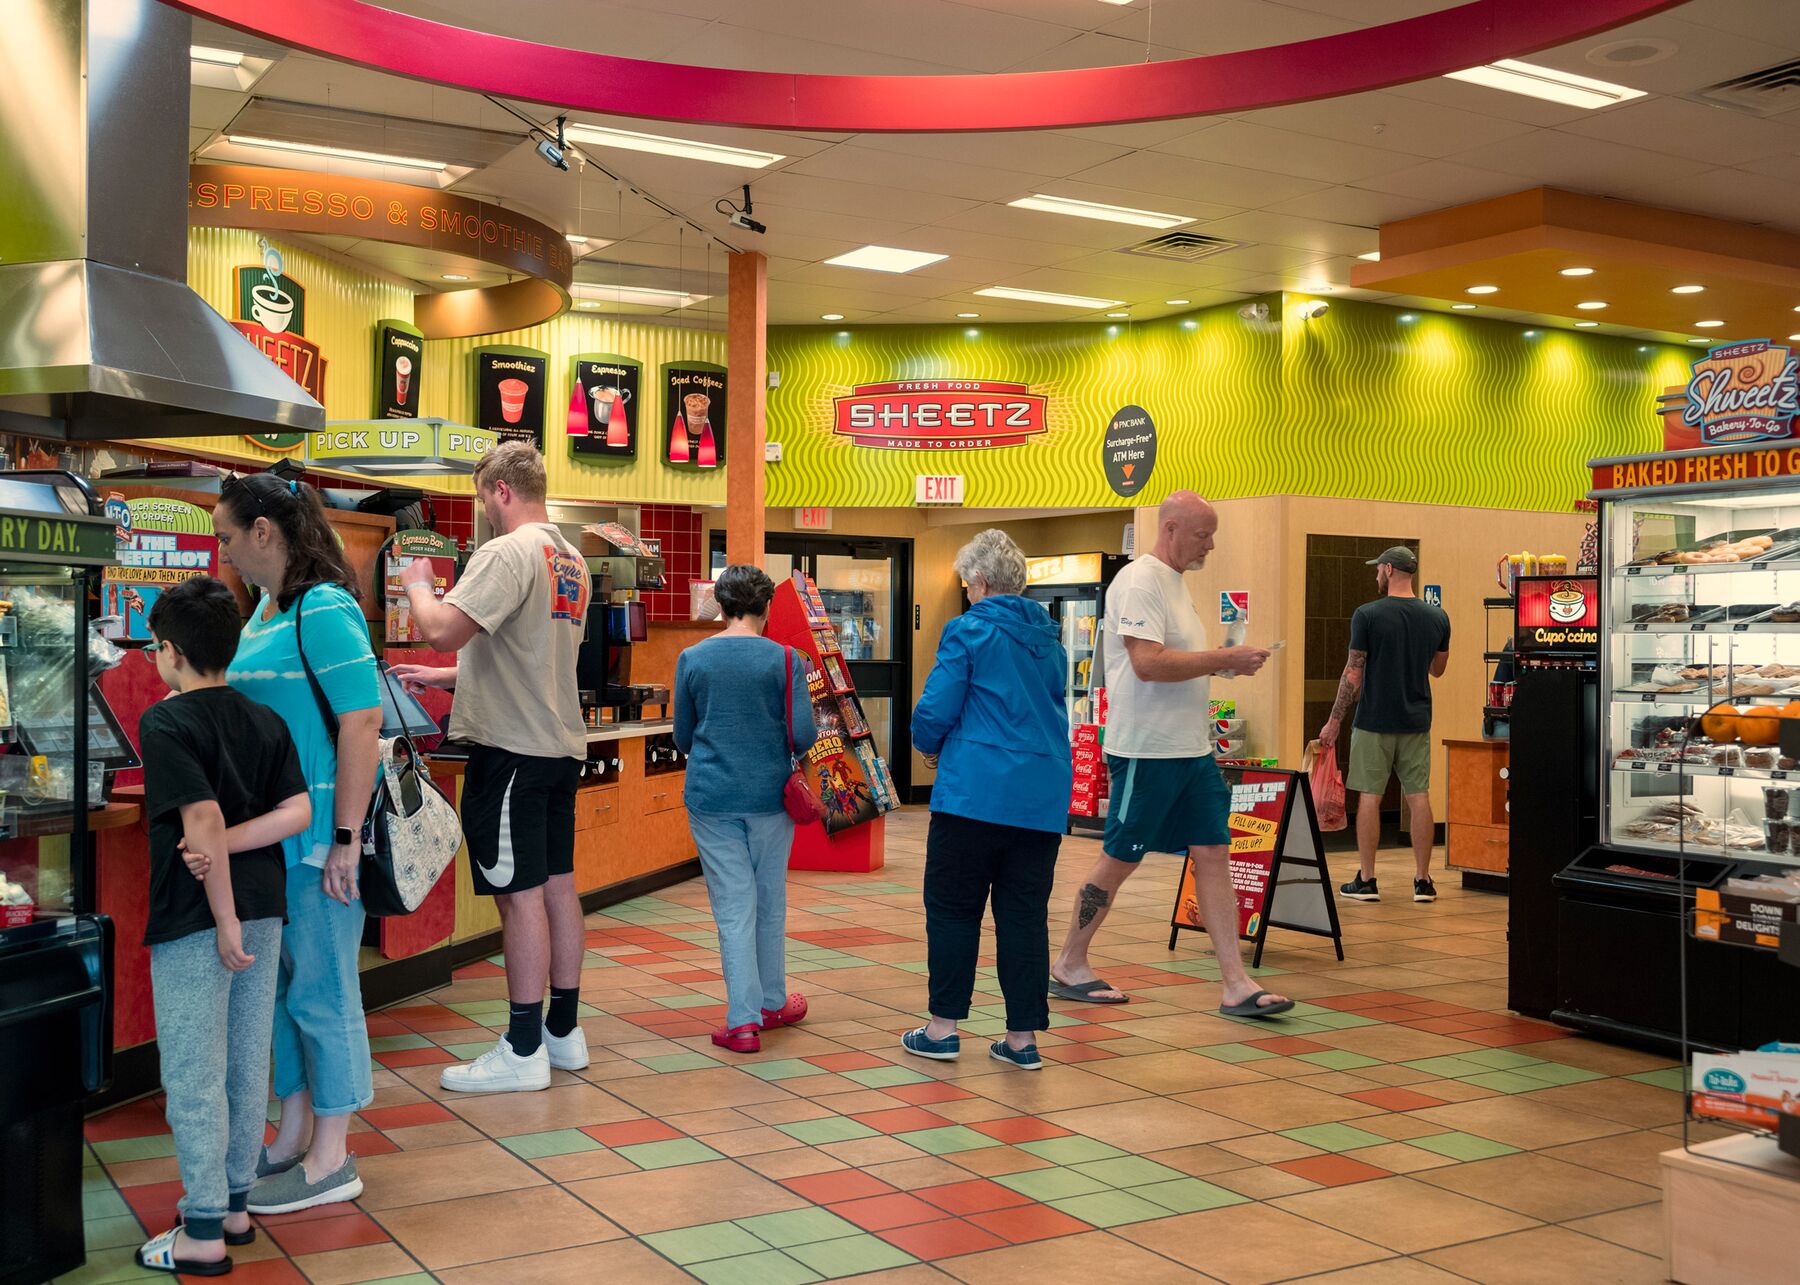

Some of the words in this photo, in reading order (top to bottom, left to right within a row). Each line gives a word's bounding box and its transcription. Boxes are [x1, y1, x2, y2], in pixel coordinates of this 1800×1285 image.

[188, 182, 374, 221] SPRESSO
[387, 200, 408, 226] &
[420, 206, 544, 261] SMOOTHIE
[391, 335, 419, 353] Cappuccino
[1714, 343, 1765, 359] SHEETZ
[246, 332, 313, 392] EETZ
[491, 359, 536, 373] Smoothiez
[591, 364, 627, 377] Espresso
[671, 376, 690, 386] Iced
[693, 375, 724, 389] Coffeez
[898, 383, 938, 391] FRESH
[948, 382, 981, 390] FOOD
[1685, 360, 1797, 422] Shweetz
[850, 403, 1032, 428] SHEETZ
[316, 431, 370, 451] PICK
[379, 431, 420, 449] UP
[449, 433, 493, 454] PICK
[887, 440, 921, 448] MADE
[950, 439, 993, 448] ORDER
[1113, 450, 1127, 463] ATM
[1128, 449, 1145, 461] Here
[1613, 459, 1677, 489] BAKED
[1684, 452, 1747, 483] FRESH
[1754, 450, 1781, 478] TO
[925, 476, 956, 500] EXIT
[128, 503, 150, 512] UCH
[153, 502, 192, 515] SCREEN
[142, 512, 175, 524] ORDER
[802, 507, 826, 527] EXIT
[38, 520, 80, 552] DAY.
[140, 534, 177, 550] THE
[402, 535, 429, 547] Espresso
[430, 534, 444, 549] Bar
[116, 551, 164, 566] HEETZ
[166, 551, 211, 567] NOT
[129, 568, 142, 580] LOVE
[143, 570, 157, 582] AND
[159, 569, 176, 581] THEN
[177, 571, 190, 583] EAT
[1535, 627, 1597, 647] Cupo'ccino
[807, 736, 843, 759] HERO
[811, 747, 844, 764] SERIES
[1231, 783, 1260, 794] WHY
[1261, 781, 1287, 792] THE
[1231, 791, 1277, 803] SHEETZ
[1230, 802, 1255, 813] NOT
[1233, 815, 1246, 828] FILL
[1247, 820, 1256, 830] UP
[1256, 822, 1271, 833] AND
[1234, 840, 1249, 851] FUEL
[1250, 838, 1263, 849] UP?
[1750, 903, 1783, 916] DOWN
